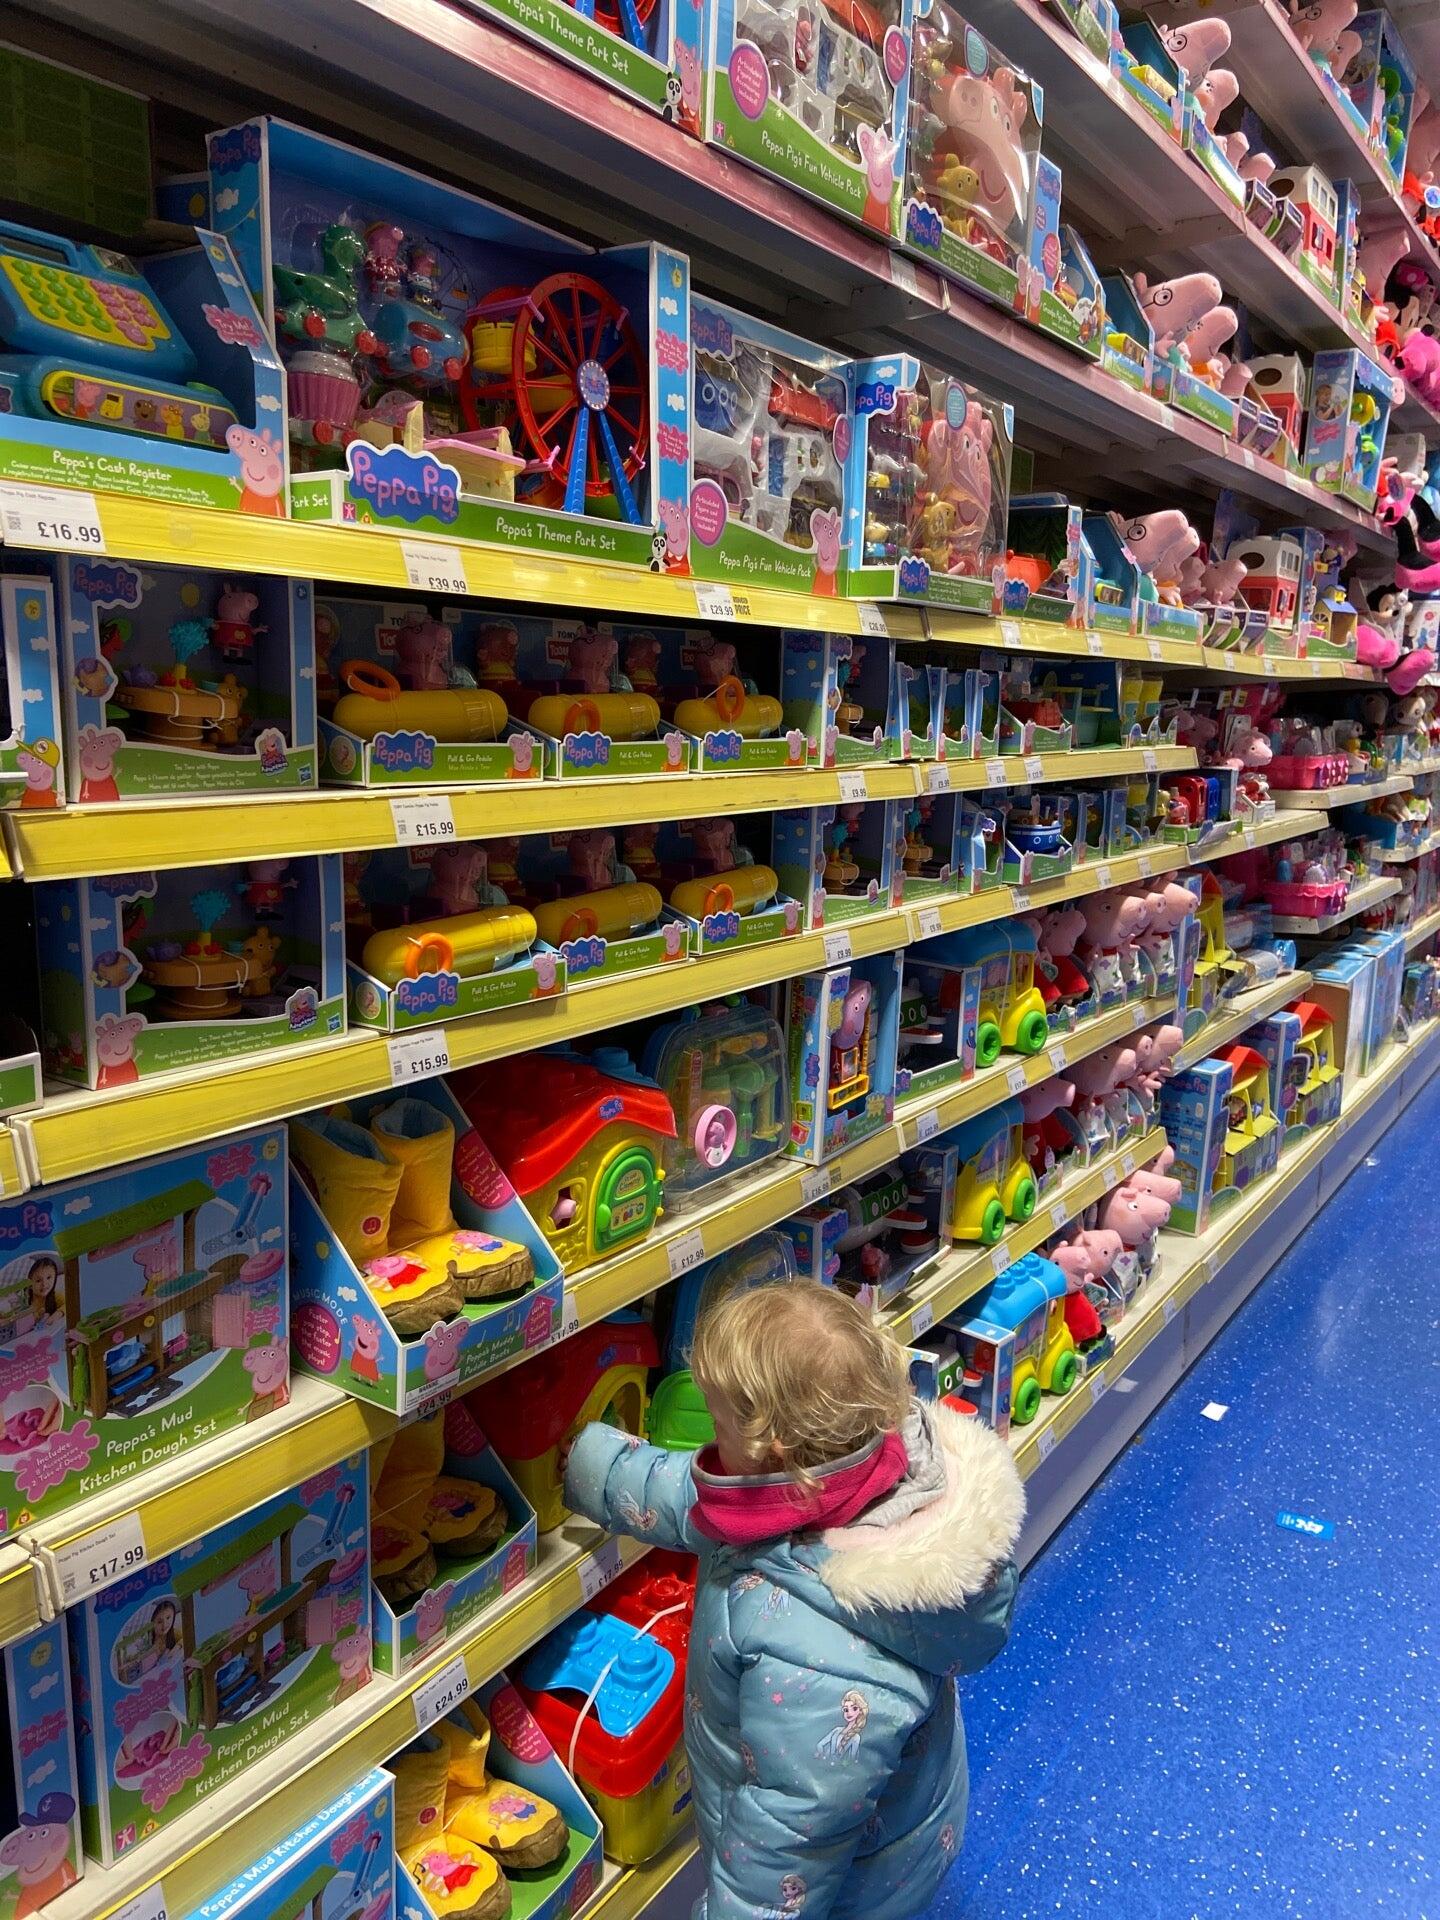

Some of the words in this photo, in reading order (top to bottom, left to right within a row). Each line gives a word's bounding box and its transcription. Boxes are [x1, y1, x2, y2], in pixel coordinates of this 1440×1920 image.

[548, 11, 584, 48] Theme
[586, 36, 609, 62] Park
[612, 52, 629, 75] Set
[761, 130, 784, 158] Peppa
[786, 144, 802, 168] Pig's
[804, 155, 818, 175] Fun
[820, 164, 844, 189] Vehicle
[846, 178, 861, 198] Pack
[215, 317, 234, 332] Try
[875, 385, 893, 408] Pig
[52, 450, 94, 471] Peppa's
[97, 458, 126, 476] Cash
[129, 465, 172, 482] Register
[353, 450, 421, 508] Peppa
[423, 465, 455, 513] Pig
[290, 494, 309, 508] Park
[312, 494, 329, 507] Set
[37, 521, 101, 544] £16.99
[496, 517, 532, 540] Peppa's
[536, 523, 571, 545] Theme
[574, 530, 597, 548] Park
[599, 534, 616, 551] Set
[719, 550, 741, 570] Peppa
[742, 554, 758, 573] Pig's
[759, 558, 772, 571] Fun
[774, 560, 797, 576] Vehicle
[797, 564, 811, 577] Pack
[75, 564, 113, 594] Peppa
[115, 572, 137, 600] Pig
[428, 577, 467, 593] £39.99
[709, 604, 733, 616] £29.99
[376, 738, 411, 768] Peppa
[414, 738, 433, 767] Pig
[465, 754, 475, 762] Go
[566, 738, 593, 761] Peppa
[595, 738, 608, 761] Pig
[706, 736, 728, 759] Peppa
[729, 735, 740, 757] Pig
[416, 822, 454, 837] £15.99
[705, 918, 726, 940] Peppa
[727, 916, 738, 937] Pig
[562, 948, 589, 971] Pppa
[590, 942, 604, 965] Pig
[400, 984, 436, 1011] Peppa
[438, 977, 457, 1002] Pig
[411, 1053, 448, 1074] £15.99
[23, 1204, 51, 1234] Pig
[681, 1248, 704, 1268] £12.99
[308, 1308, 328, 1324] Faster
[321, 1292, 348, 1324] MODE
[313, 1331, 332, 1347] faster
[313, 1345, 331, 1359] music
[491, 1335, 514, 1351] Muddy
[490, 1350, 510, 1363] Boots
[107, 1425, 156, 1459] Peppa's
[161, 1406, 193, 1433] Mud
[80, 1464, 137, 1494] Kitchen
[142, 1437, 188, 1472] Dough
[193, 1418, 217, 1442] Set
[89, 1545, 144, 1584] £17.99
[435, 1678, 468, 1713] £24.99
[217, 1728, 259, 1760] Peppa's
[262, 1703, 290, 1729] Mud
[195, 1760, 243, 1798] Kitchen
[246, 1731, 286, 1763] Dough
[289, 1710, 310, 1734] Set
[200, 1881, 247, 1918] Peppa's
[243, 1856, 276, 1881] Mud
[272, 1820, 320, 1858] Kitchen
[317, 1791, 356, 1822] Dough
